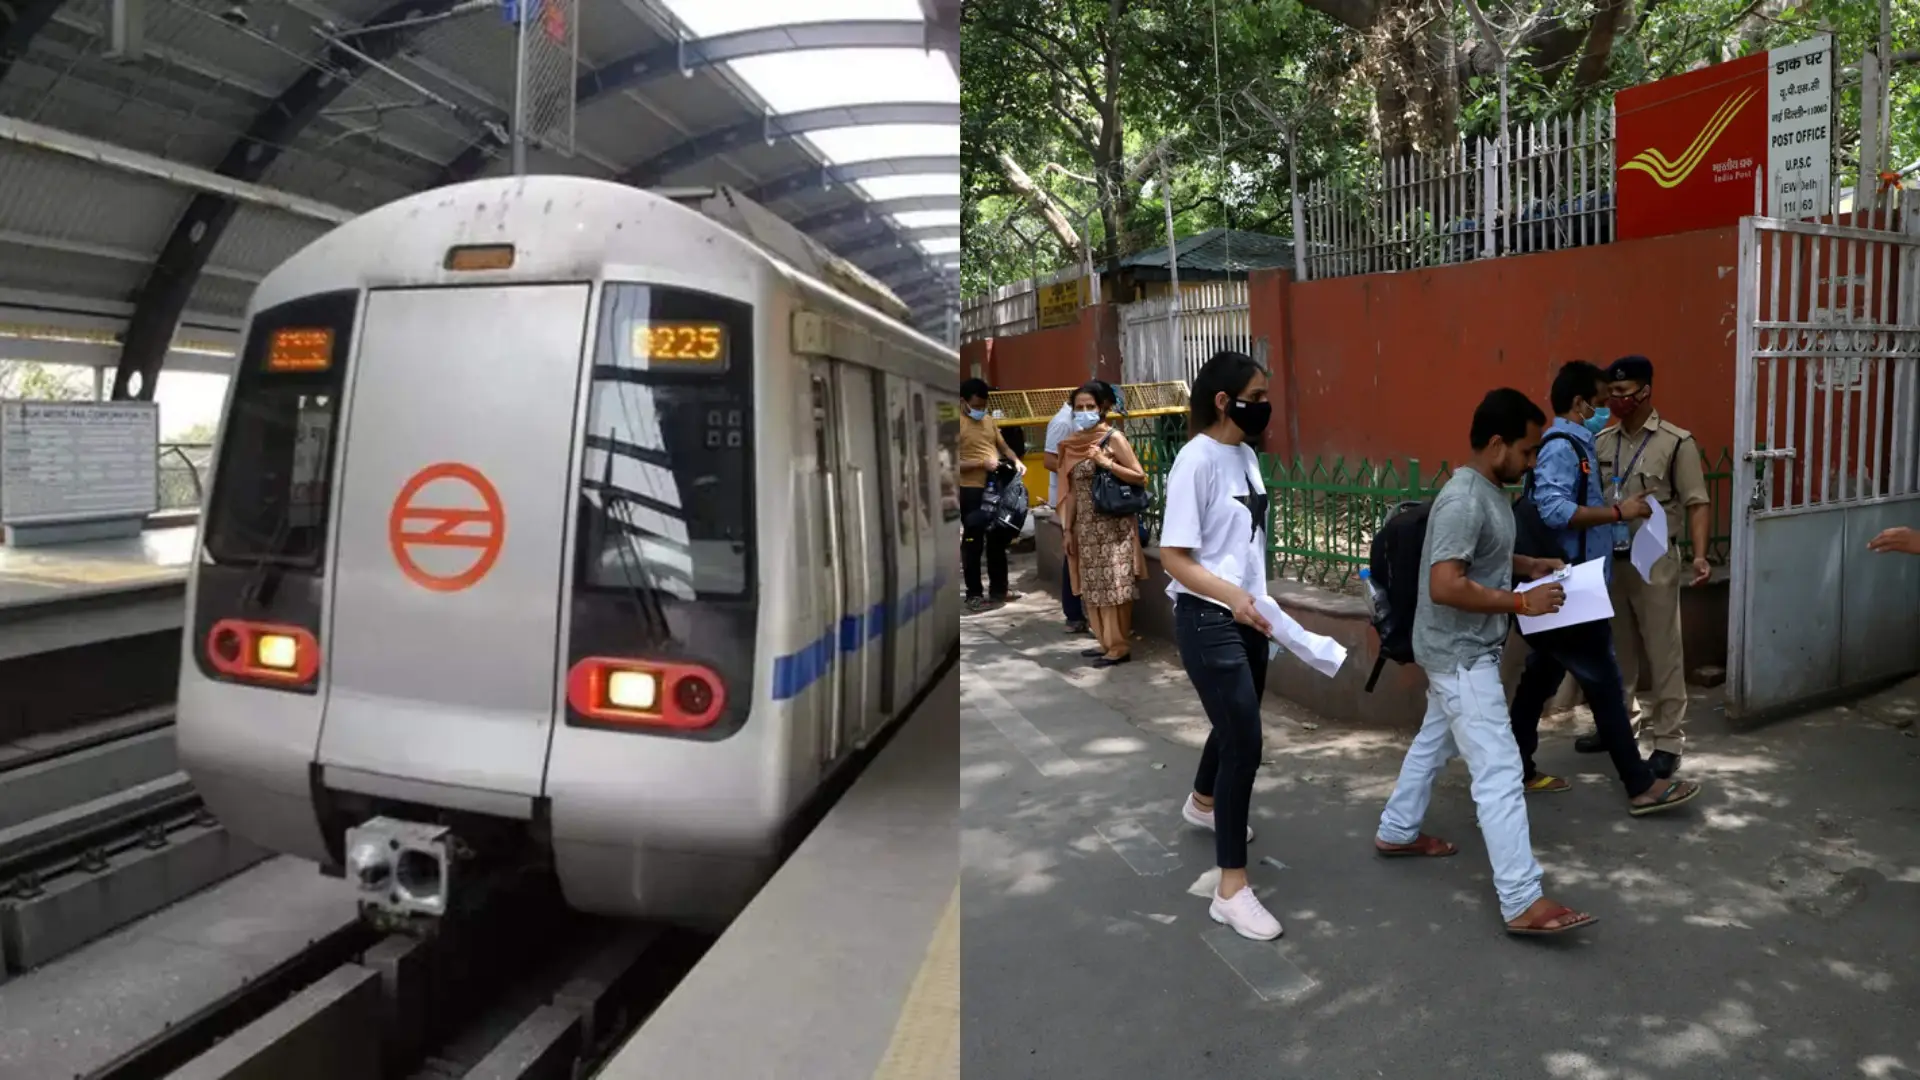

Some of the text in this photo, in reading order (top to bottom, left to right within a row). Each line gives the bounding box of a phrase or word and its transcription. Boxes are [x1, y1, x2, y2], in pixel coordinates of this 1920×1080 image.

[1776, 51, 1823, 75] डाक घर
[1772, 126, 1826, 148] POST OFFICE
[1785, 156, 1812, 171] U.P.S.C
[1714, 170, 1752, 183] India Post
[1800, 178, 1818, 191] Delh
